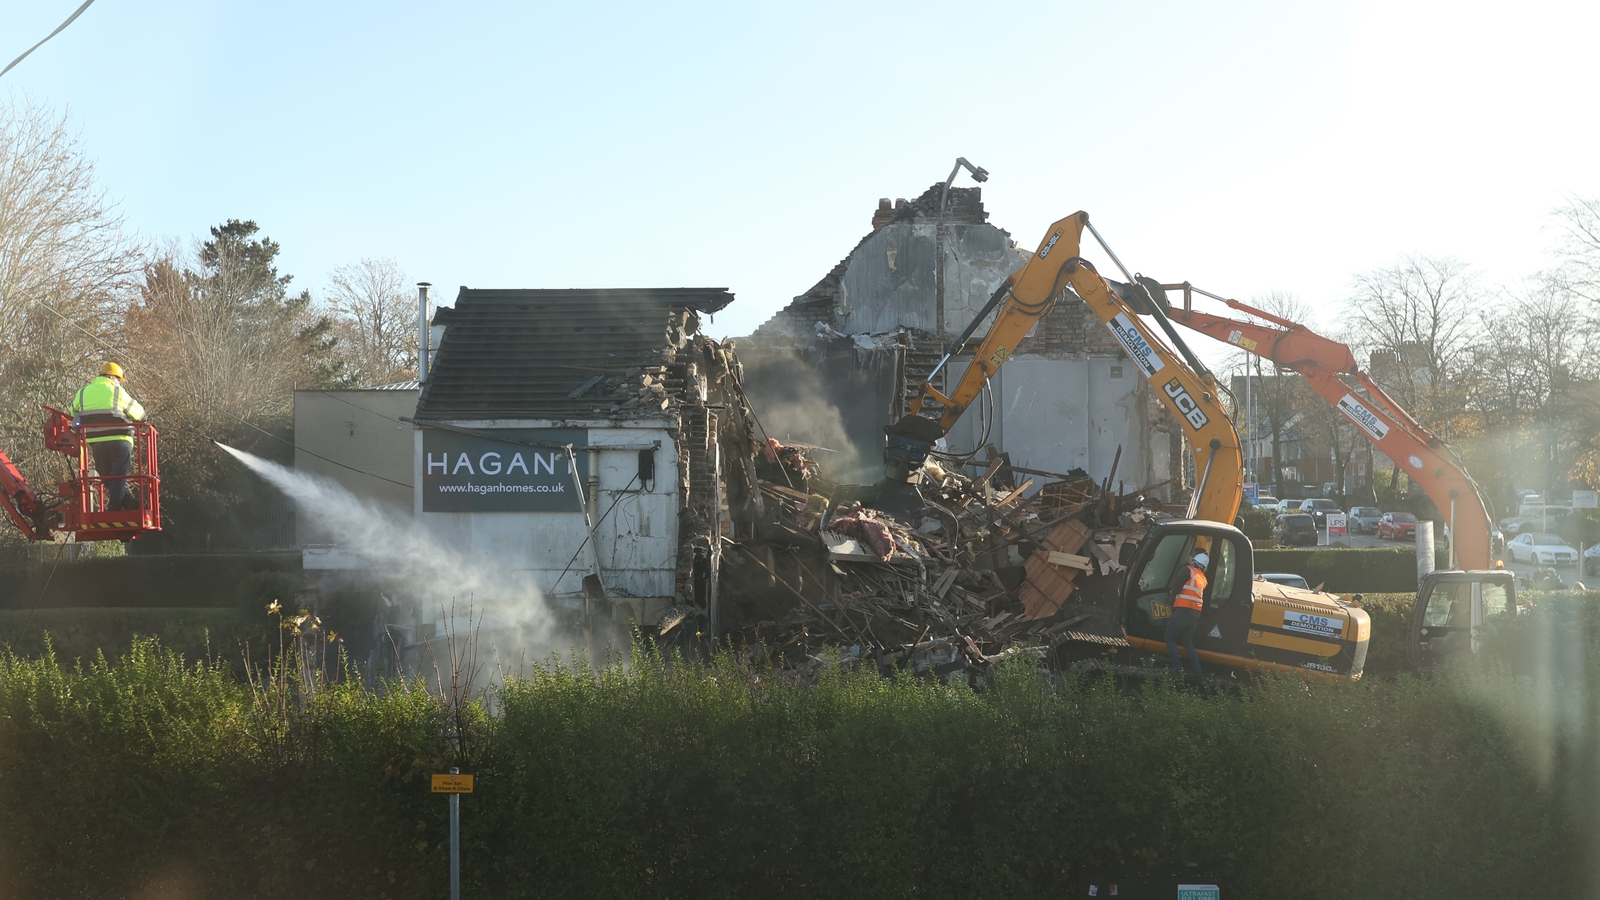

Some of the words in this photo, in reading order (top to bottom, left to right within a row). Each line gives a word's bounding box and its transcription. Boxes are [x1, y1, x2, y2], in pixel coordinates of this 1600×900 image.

[1116, 326, 1150, 368] DEMOLITION
[1127, 327, 1152, 357] CMS
[1164, 383, 1207, 430] JCB
[1354, 404, 1378, 425] CMS
[1345, 405, 1378, 433] DEMOLITION
[427, 451, 555, 476] HAGAN
[439, 482, 565, 495] www.haganhomes.co.uk
[1154, 602, 1171, 617] JCB
[1299, 614, 1329, 626] CMS
[1291, 621, 1334, 633] DEMOLITION
